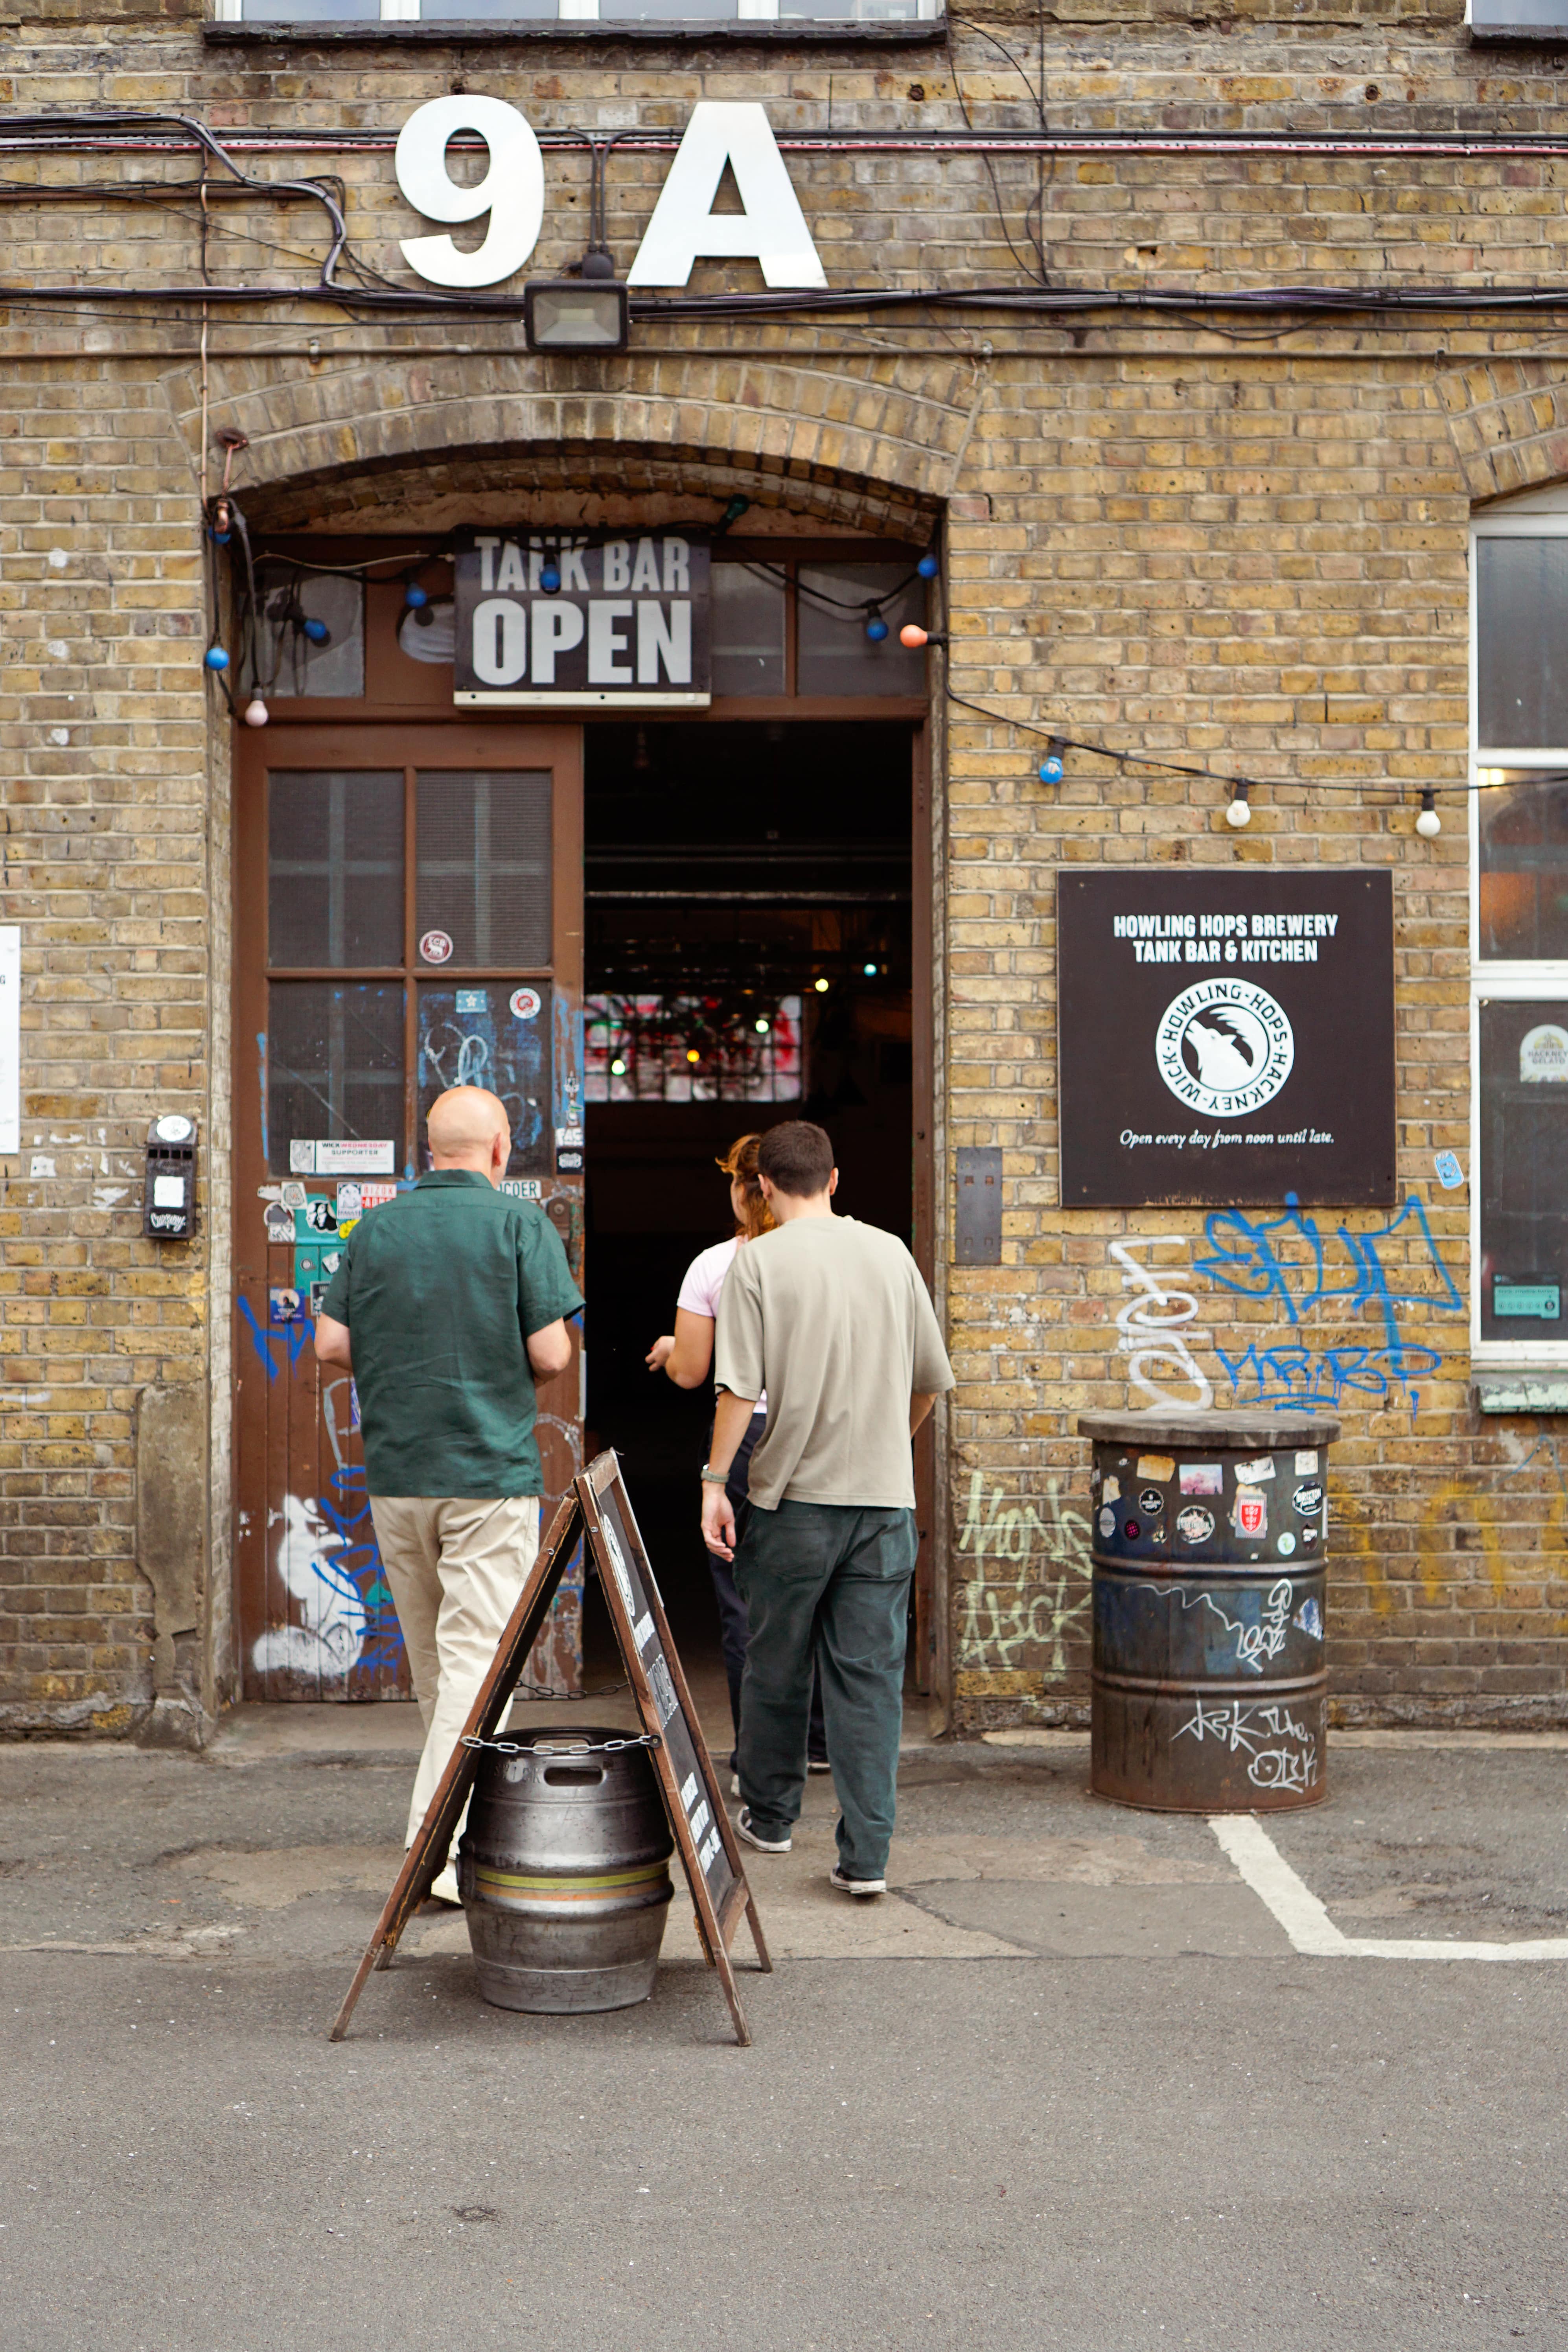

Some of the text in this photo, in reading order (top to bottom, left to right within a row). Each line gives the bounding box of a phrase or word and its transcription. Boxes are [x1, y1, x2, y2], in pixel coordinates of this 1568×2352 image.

[603, 536, 690, 591] BAR
[473, 598, 692, 686] OPEN
[1113, 914, 1338, 938] HOWLING HOPS BREWERY
[1133, 940, 1318, 963] TANK BAR & KITCHEN
[1163, 984, 1287, 1110] HOWLING HOPS HACKNEY WICK
[1120, 1128, 1334, 1149] Open every day from noon until late.
[1296, 1487, 1321, 1503] BRIXTON
